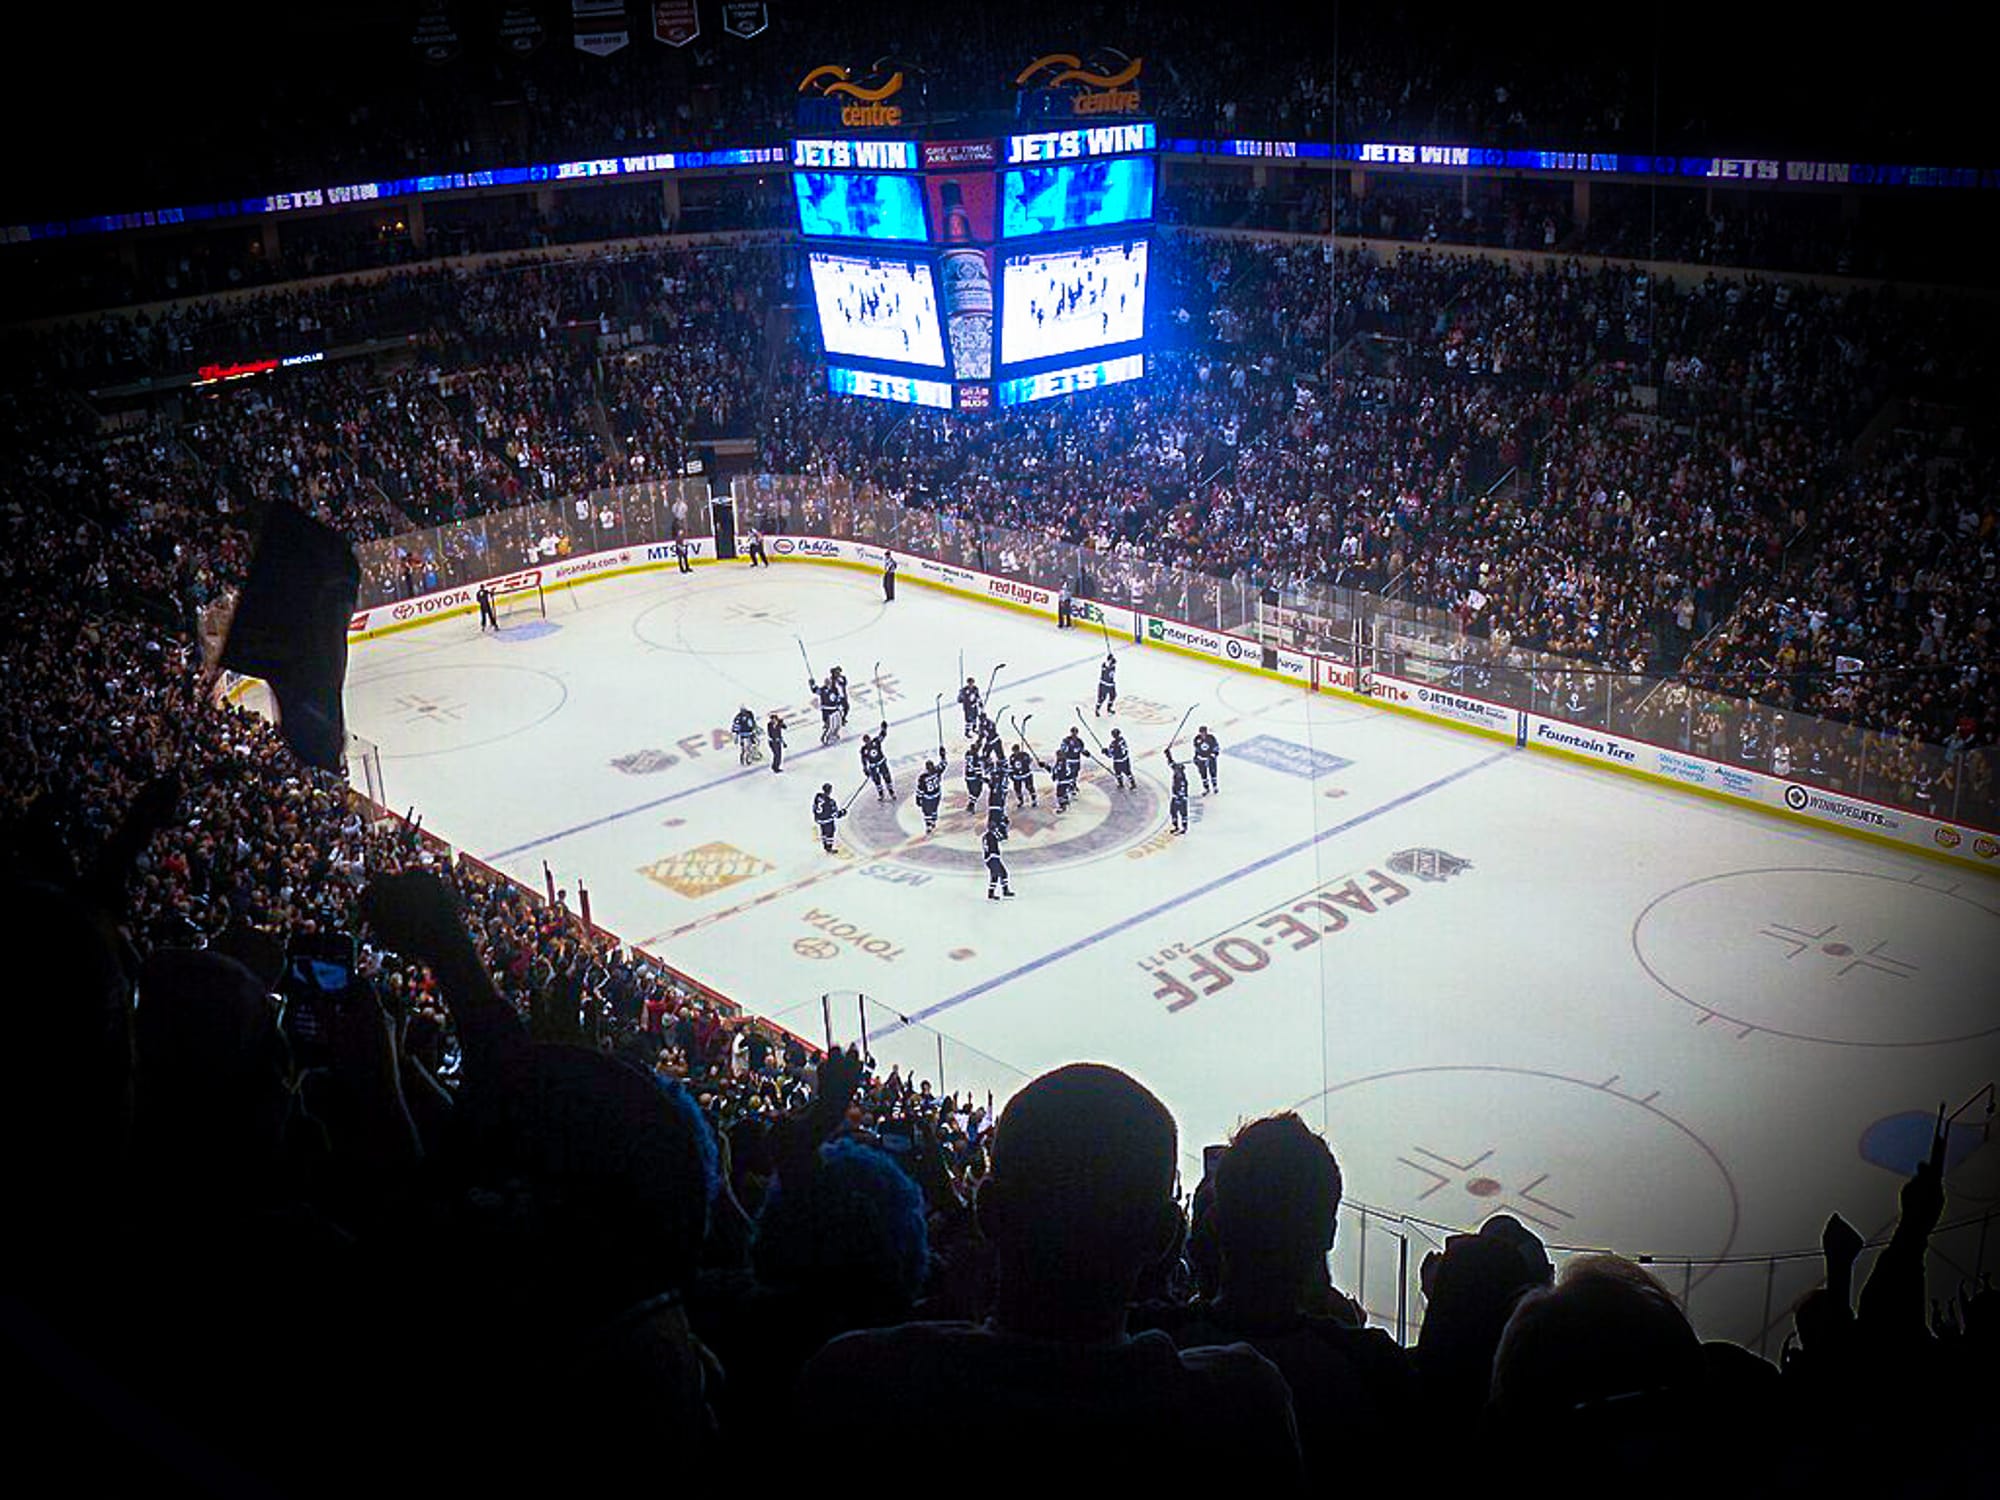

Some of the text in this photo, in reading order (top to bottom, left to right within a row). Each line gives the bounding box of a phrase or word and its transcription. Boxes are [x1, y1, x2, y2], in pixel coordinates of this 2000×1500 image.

[842, 102, 902, 126] centre
[794, 140, 850, 167] JETS
[855, 142, 907, 168] WIN
[1008, 125, 1146, 164] JETS WIN
[1359, 143, 1470, 165] JETS WIN
[557, 152, 675, 179] JETS WIN
[1706, 158, 1850, 182] JETS WIN
[265, 188, 323, 213] JETS
[416, 591, 471, 614] TOYOTA
[1070, 602, 1105, 624] edEx
[1429, 692, 1454, 708] JETS
[1455, 698, 1486, 716] GEAR
[1537, 724, 1636, 763] Fountain Tire
[801, 908, 906, 962] TOYOTA
[1153, 868, 1411, 1014] FACE-OFF
[1137, 941, 1193, 972] 2011
